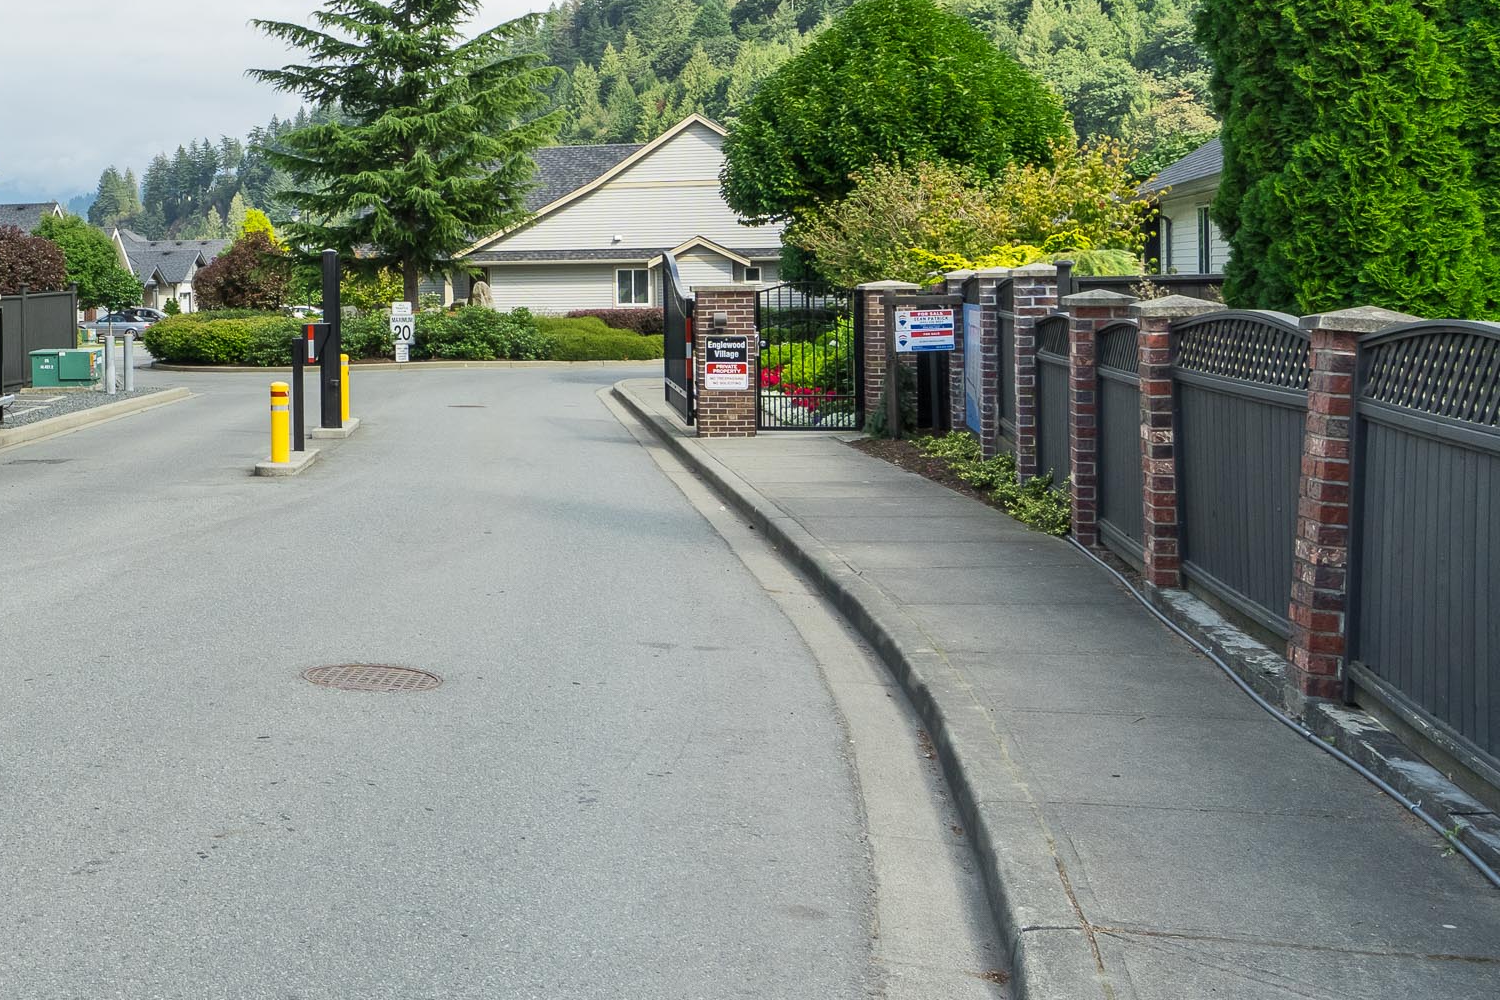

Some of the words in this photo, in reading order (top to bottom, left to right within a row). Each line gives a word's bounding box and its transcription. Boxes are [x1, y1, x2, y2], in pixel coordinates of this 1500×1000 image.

[394, 325, 411, 340] 20
[707, 341, 746, 350] Englewood
[714, 350, 739, 359] Village
